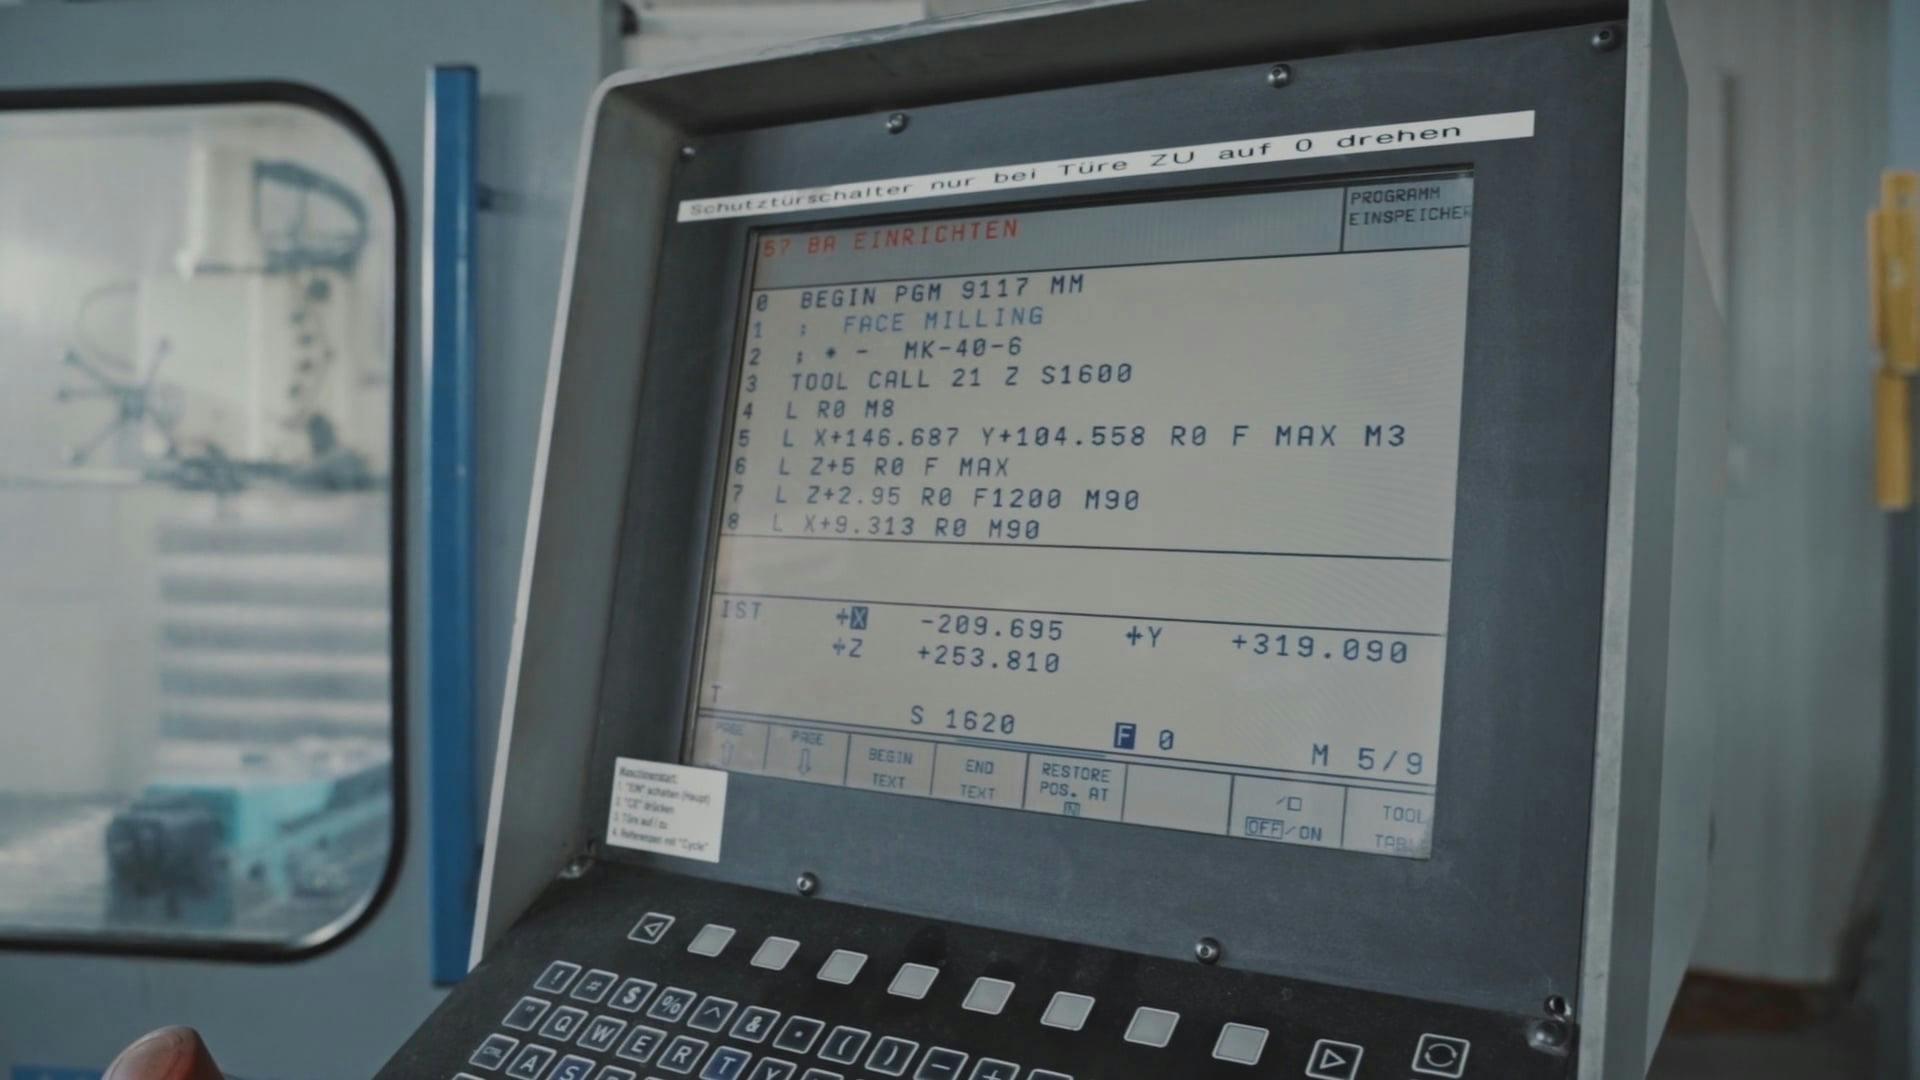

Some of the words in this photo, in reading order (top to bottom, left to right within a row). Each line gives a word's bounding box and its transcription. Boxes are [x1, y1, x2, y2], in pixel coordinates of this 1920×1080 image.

[691, 182, 914, 216] Schutztürschalter
[930, 176, 976, 191] nur
[994, 168, 1037, 184] bei
[1062, 159, 1127, 177] Türe
[1150, 151, 1195, 167] ZU
[1218, 142, 1271, 160] auf
[1336, 124, 1461, 149] drehen
[1350, 187, 1441, 205] PROGRAMM
[854, 219, 1019, 250] EINRICHTEN
[801, 287, 876, 309] BEGIN
[896, 283, 941, 304] PGM
[962, 277, 1028, 300] 9117
[1051, 274, 1084, 295] MM
[753, 321, 763, 339] 1
[844, 313, 905, 334] FACE
[925, 307, 1044, 330] MILLING
[750, 347, 761, 366] 2
[904, 337, 1022, 360] MK-40-6
[746, 375, 757, 393] 3
[792, 372, 848, 391] TOOL
[868, 370, 931, 391] CALL
[952, 368, 981, 388] 21
[1005, 366, 1019, 386] Z
[1040, 363, 1132, 385] S1600
[742, 402, 753, 420] 4
[786, 401, 797, 419] L
[817, 400, 846, 419] R0
[864, 399, 894, 418] M8
[738, 429, 750, 448] 5
[783, 428, 794, 447] L
[814, 427, 960, 448] X+146.687
[982, 425, 1147, 448] Y+104.558
[1170, 425, 1207, 447] R0
[1232, 425, 1249, 447] F
[1274, 425, 1338, 448] MAX
[1364, 425, 1406, 448] M3
[734, 456, 746, 475] 6
[780, 457, 791, 476] L
[809, 457, 855, 476] Z+5
[874, 456, 905, 476] R0
[924, 456, 939, 476] F
[959, 457, 1010, 478] MAX
[732, 484, 744, 503] 7
[775, 485, 787, 504] L
[806, 486, 901, 506] Z+2.95
[920, 487, 953, 507] R0
[973, 488, 1062, 509] F1200
[1084, 489, 1141, 511] M90
[727, 511, 740, 530] 8
[772, 513, 783, 532] L
[804, 514, 915, 536] X+9.313
[935, 517, 967, 537] R0
[988, 519, 1040, 540] M90
[722, 600, 762, 620] IST
[921, 614, 1064, 641] -209.695
[1232, 633, 1408, 663] +319.090
[918, 646, 1060, 674] +253.810
[711, 685, 722, 704] T
[791, 732, 825, 747] PAGE
[911, 705, 924, 725] S
[945, 708, 1016, 735] 1620
[1115, 723, 1136, 748] F
[1312, 743, 1329, 766] M
[1358, 747, 1424, 775] 5/9
[868, 748, 913, 765] BEGIN
[965, 759, 995, 775] END
[873, 773, 906, 789] TEXT
[1042, 762, 1112, 783] RESTORE
[960, 783, 997, 800] TEXT
[1040, 781, 1077, 798] POS.
[1088, 787, 1109, 801] AT
[1383, 805, 1425, 824] TOOL
[623, 986, 640, 1004] $
[663, 996, 681, 1015] %
[745, 1016, 762, 1033] &
[838, 1035, 852, 1055] (
[883, 1045, 898, 1066] )
[554, 1015, 572, 1033] Q
[592, 1025, 615, 1042] W
[631, 1036, 652, 1053] E
[671, 1047, 693, 1064] R
[720, 1056, 737, 1074] T
[520, 1055, 537, 1073] A
[563, 1065, 580, 1080] S
